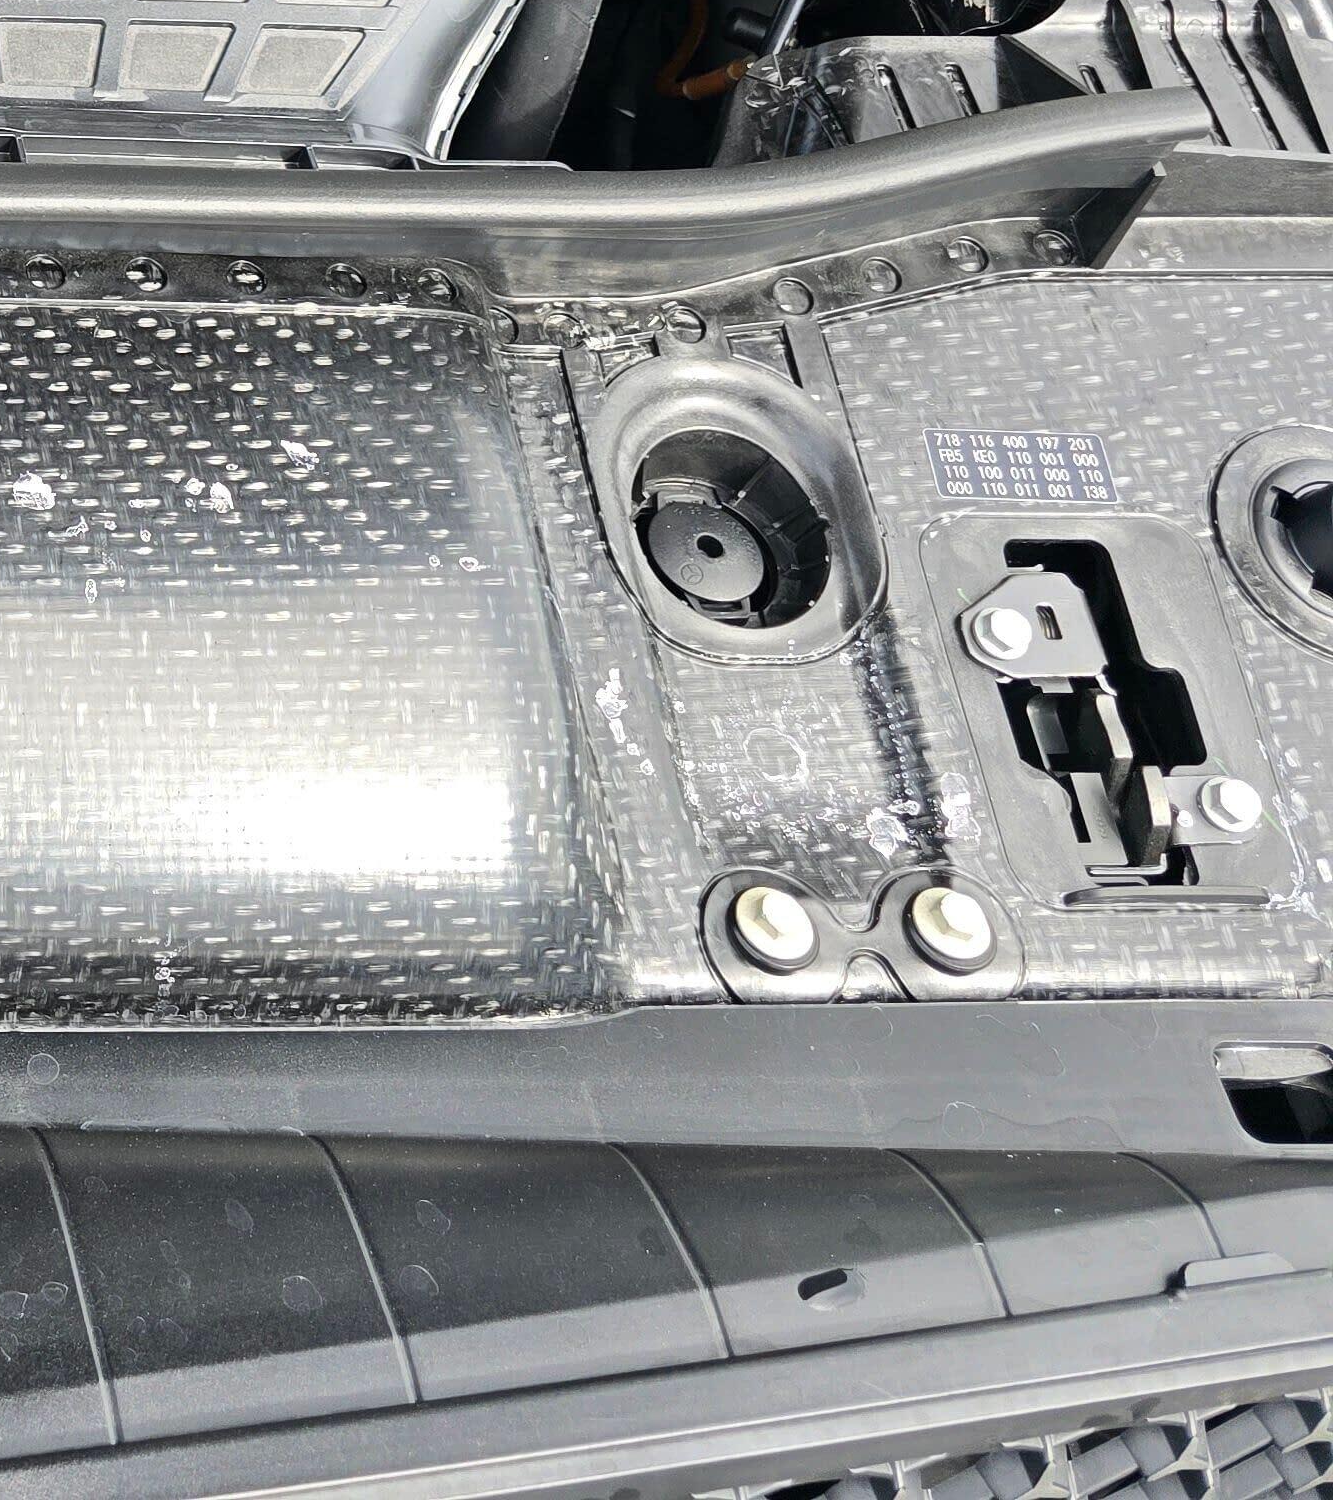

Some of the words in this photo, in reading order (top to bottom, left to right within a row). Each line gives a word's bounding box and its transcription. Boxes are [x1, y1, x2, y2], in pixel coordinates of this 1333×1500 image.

[969, 434, 995, 448] 116
[1002, 435, 1028, 449] 400
[1035, 437, 1059, 450] 197
[1067, 438, 1094, 451] 201
[939, 449, 964, 462] FB5
[1007, 451, 1032, 465] 110
[1039, 452, 1065, 466] 001
[1073, 454, 1099, 467] 000
[944, 465, 969, 479] 110
[978, 466, 1003, 480] 100
[1010, 467, 1036, 480] 011
[1044, 468, 1070, 482] 000
[1078, 469, 1104, 483] 110
[946, 481, 973, 495] 000
[982, 482, 1008, 496] 110
[1014, 483, 1040, 497] 011
[1048, 484, 1074, 499] 001
[1083, 485, 1109, 499] 138
